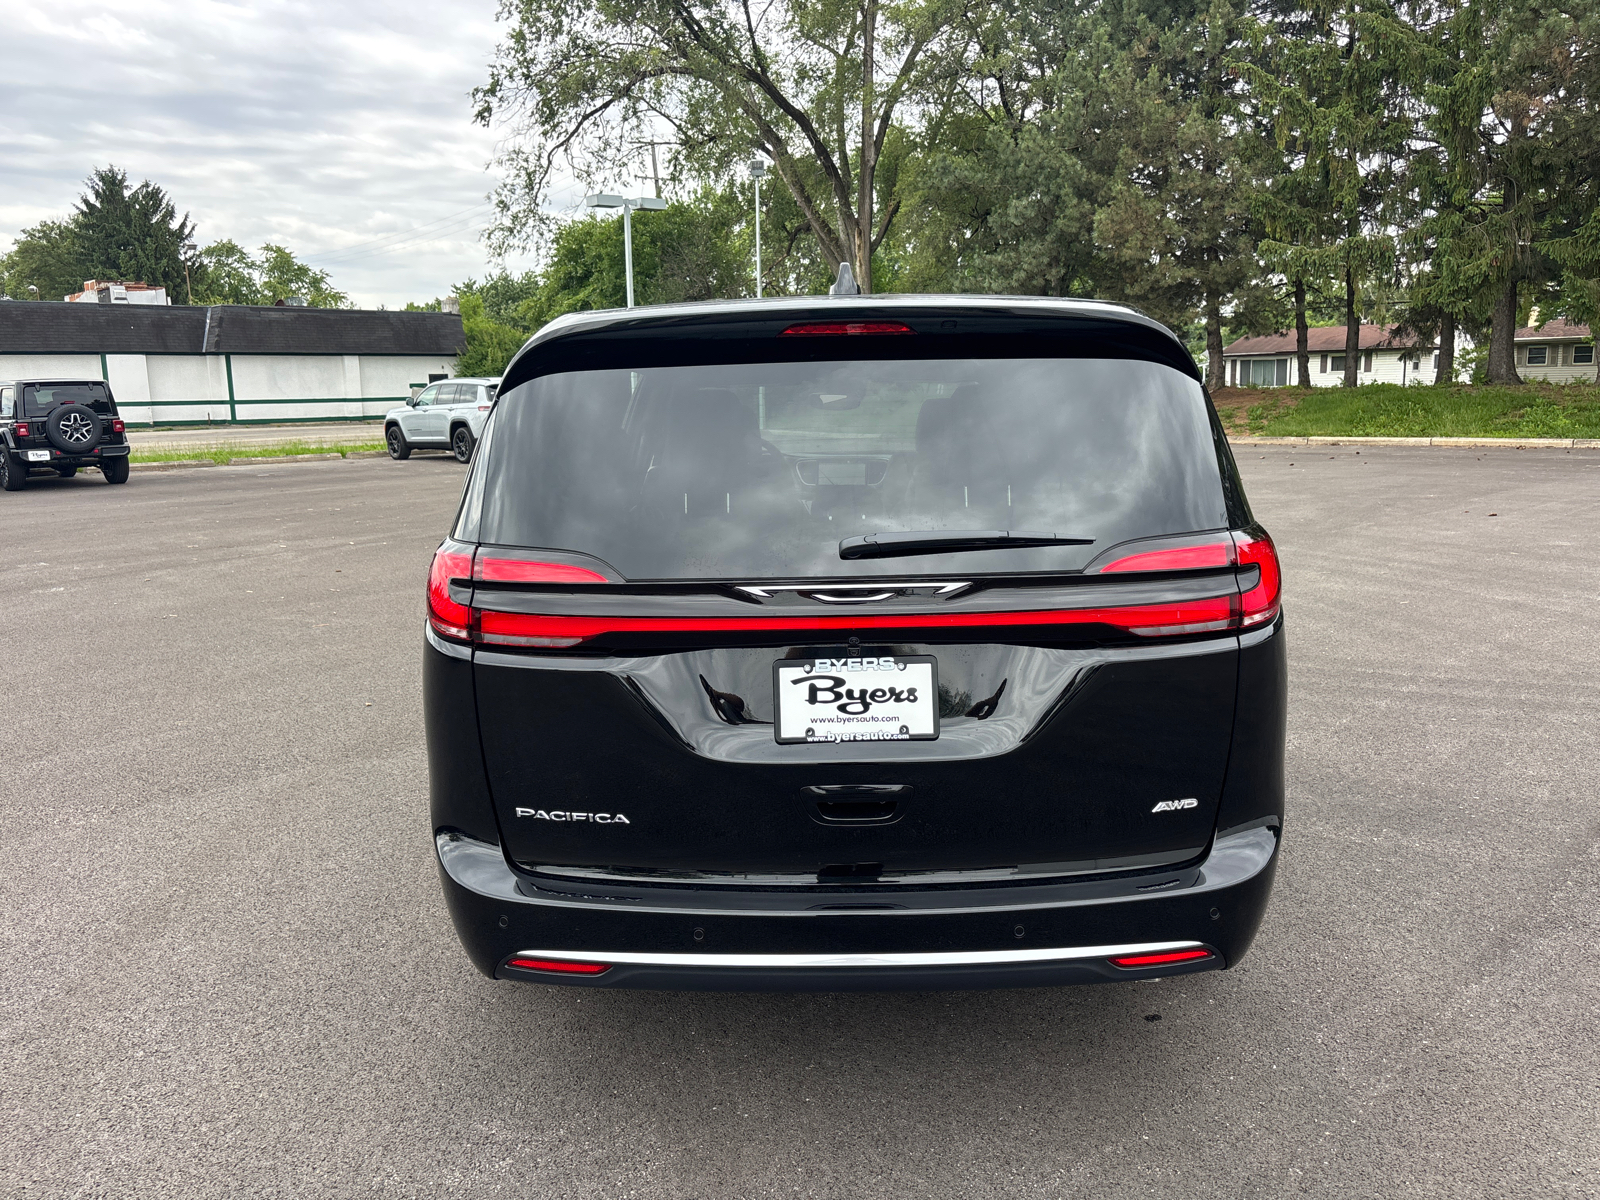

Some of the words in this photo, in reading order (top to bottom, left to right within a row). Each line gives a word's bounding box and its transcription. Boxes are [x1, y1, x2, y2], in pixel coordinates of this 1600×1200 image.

[814, 657, 896, 673] BYERS
[790, 675, 918, 715] Byers
[810, 714, 900, 725] www.byersauto.com
[806, 730, 909, 743] www.byersauto.com
[1151, 798, 1199, 813] AWD
[515, 807, 631, 824] PACIFICA
